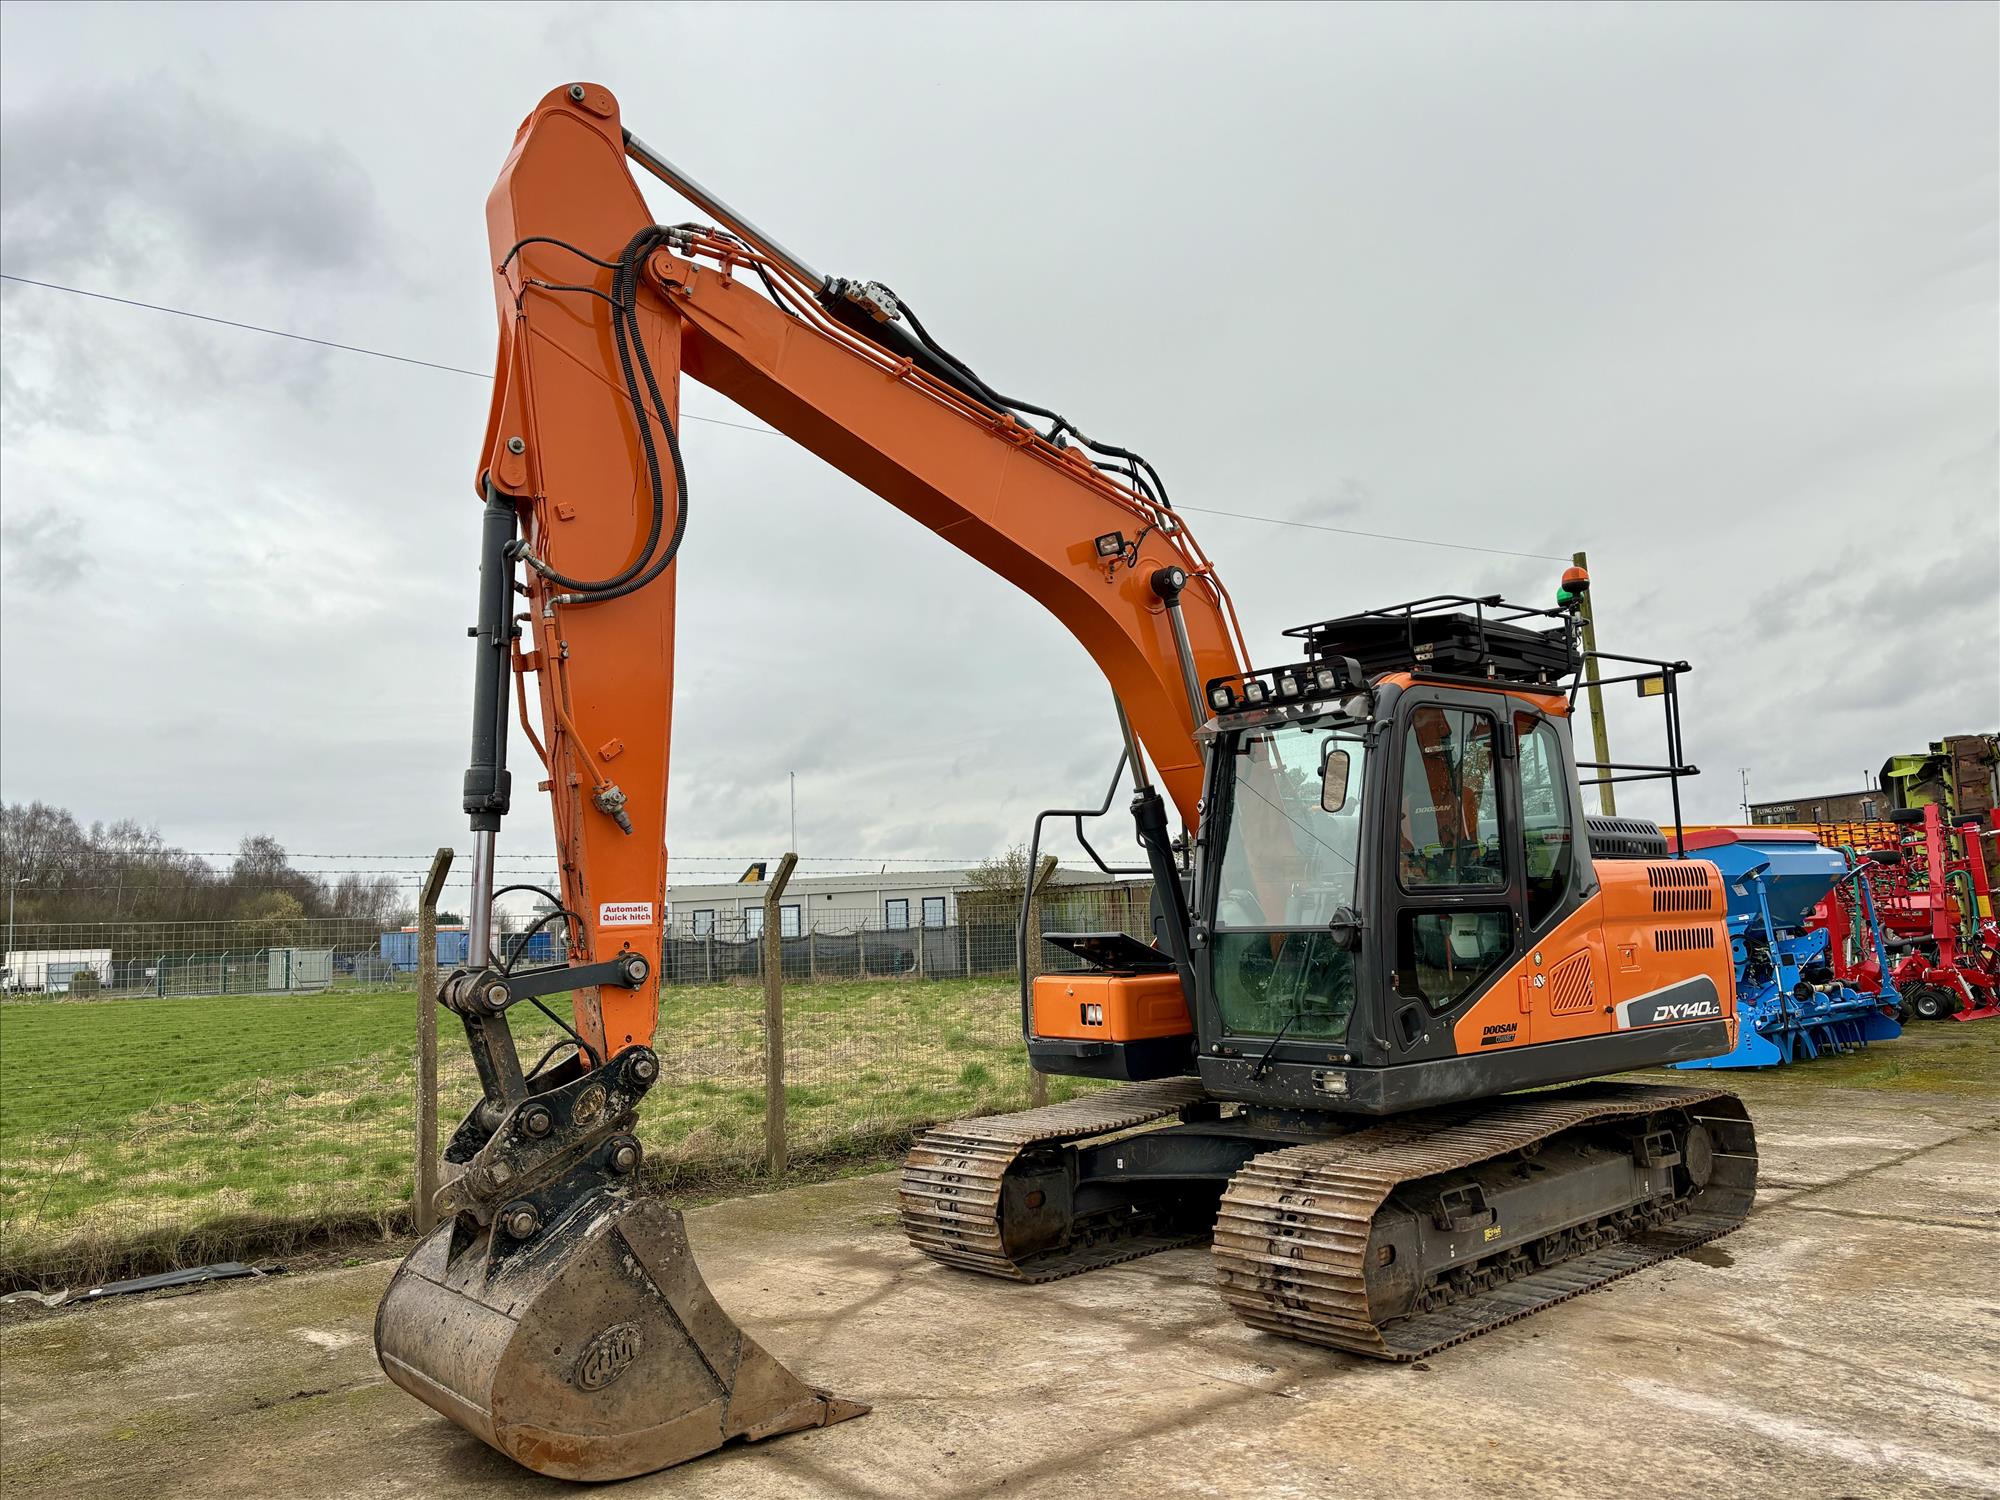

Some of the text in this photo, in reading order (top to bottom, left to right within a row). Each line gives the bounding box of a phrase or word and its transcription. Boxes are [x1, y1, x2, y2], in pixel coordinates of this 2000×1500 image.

[1415, 804, 1452, 815] DOOSAN
[605, 905, 649, 914] Automatic
[603, 913, 651, 922] Quick hitch
[1483, 1022, 1518, 1036] DOOSAN
